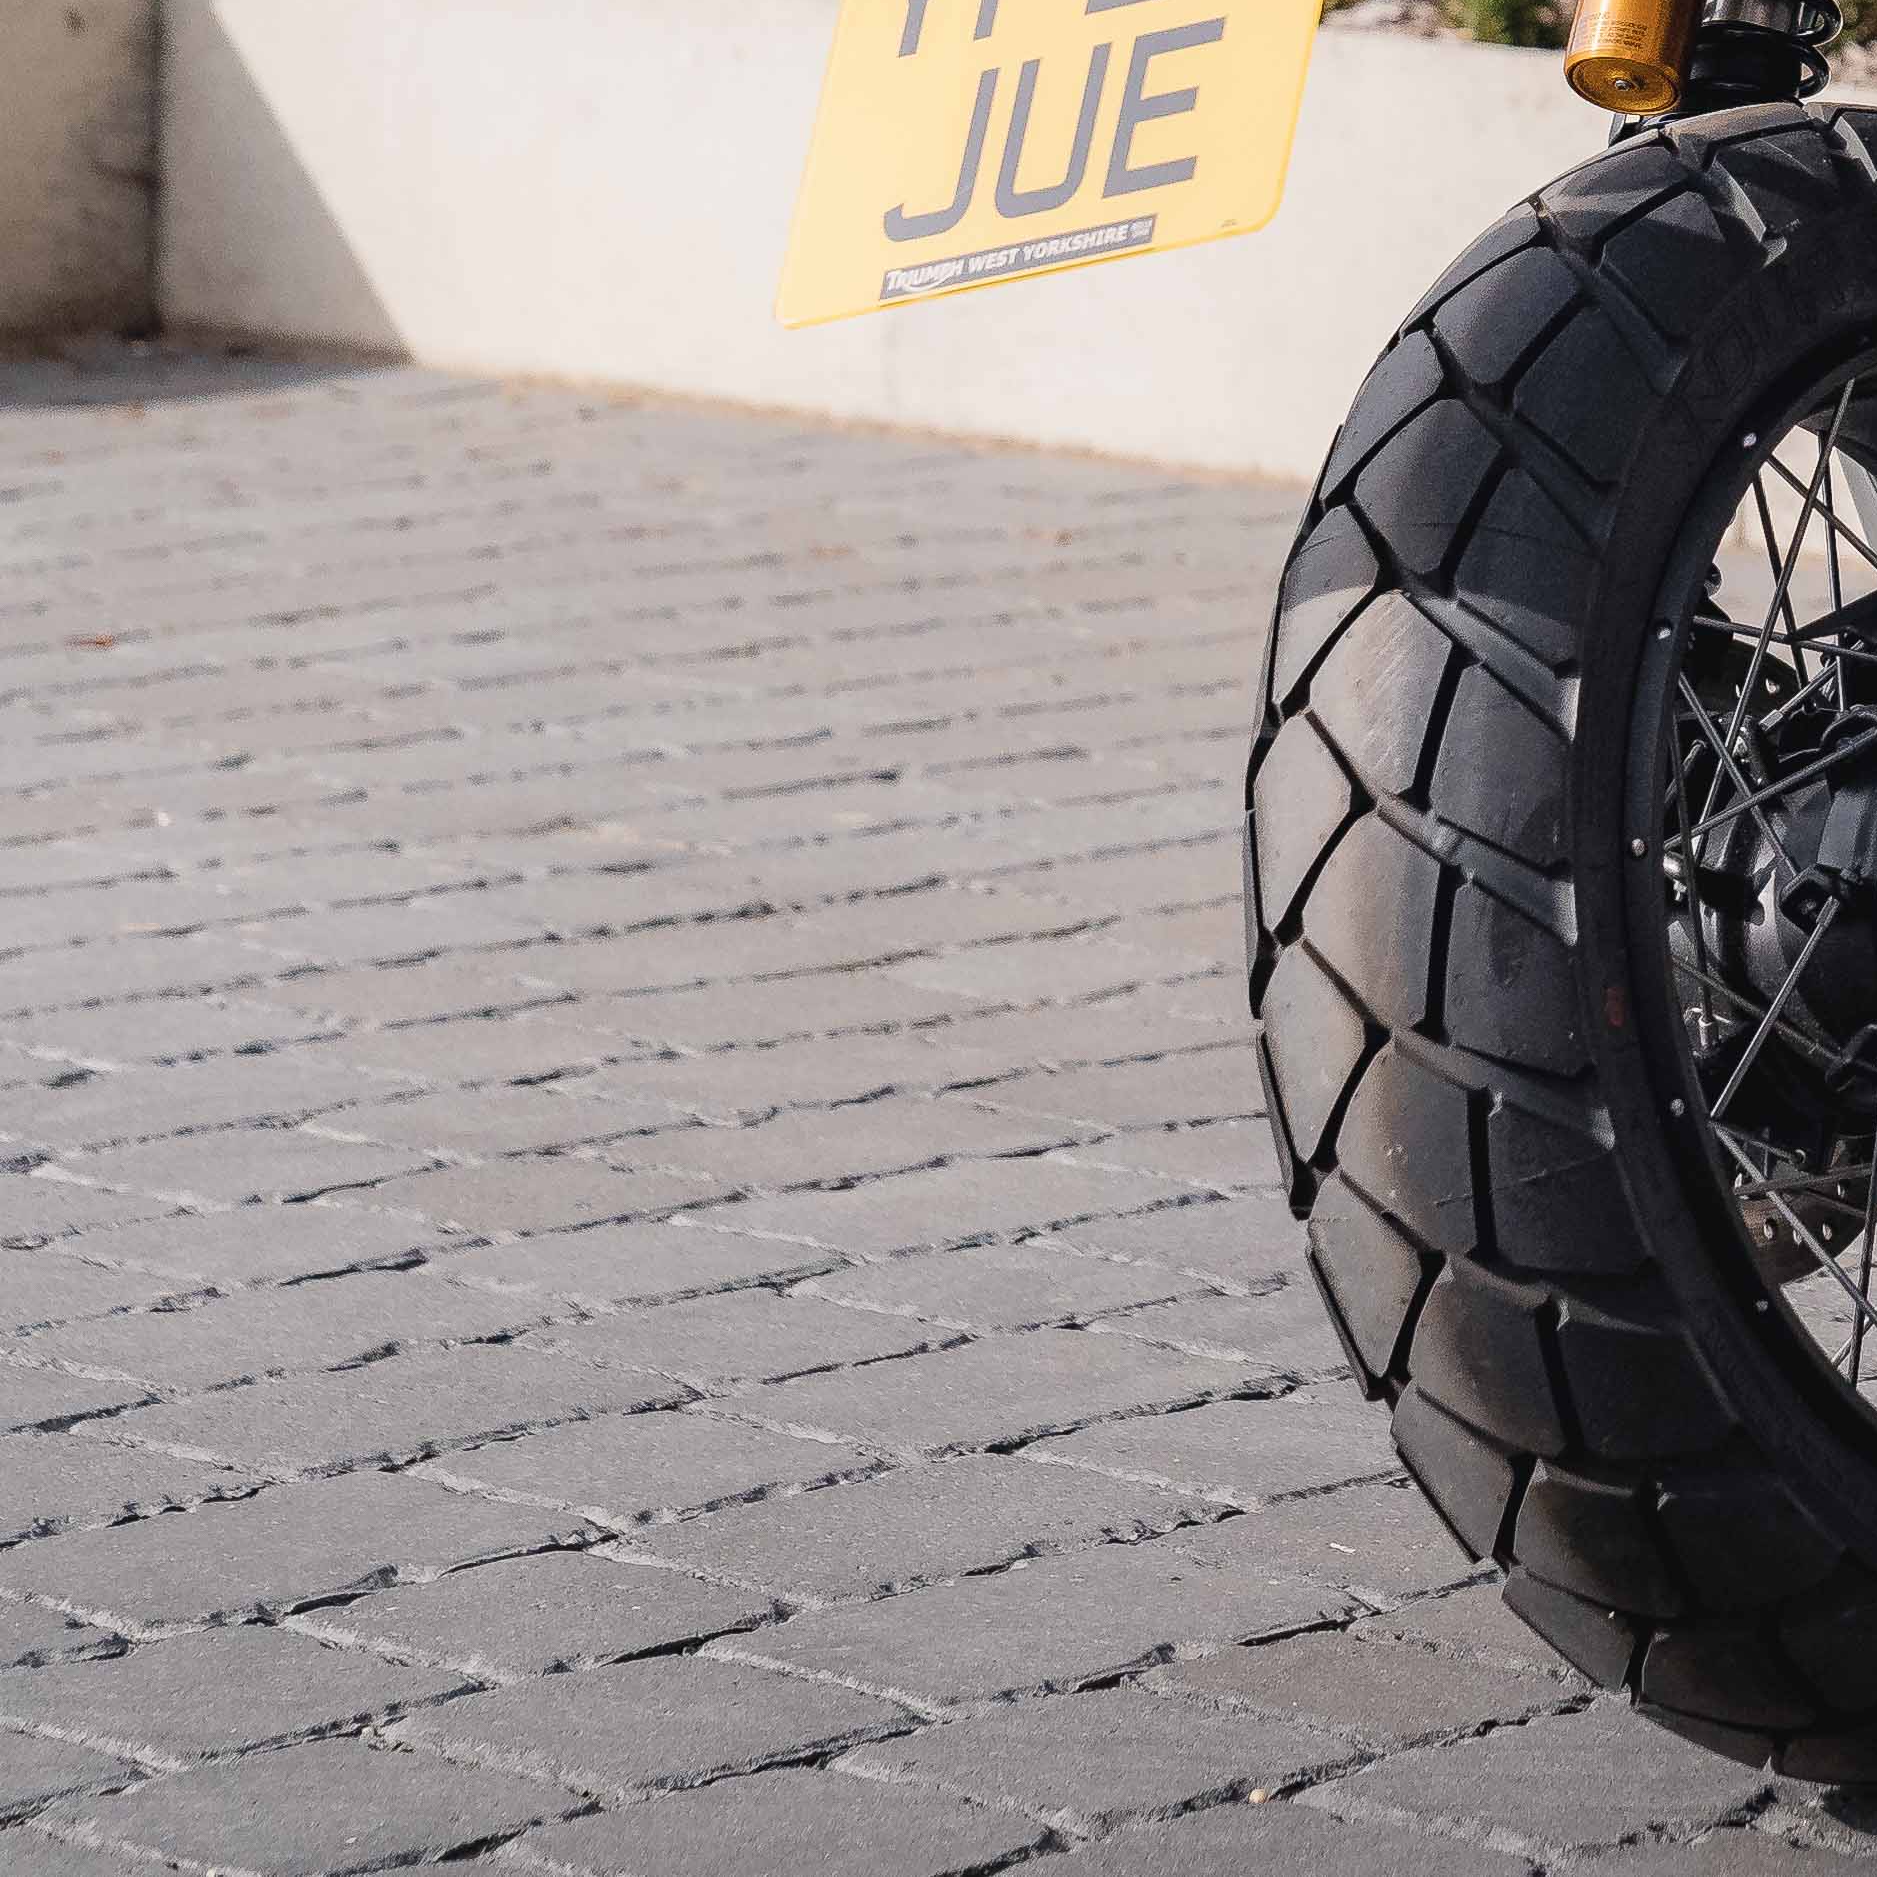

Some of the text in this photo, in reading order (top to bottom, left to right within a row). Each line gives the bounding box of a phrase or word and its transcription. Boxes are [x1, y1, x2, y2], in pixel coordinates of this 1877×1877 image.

[883, 16, 1227, 242] JUE
[886, 224, 1129, 293] TRIUMPH WEST YORKSHIRE
